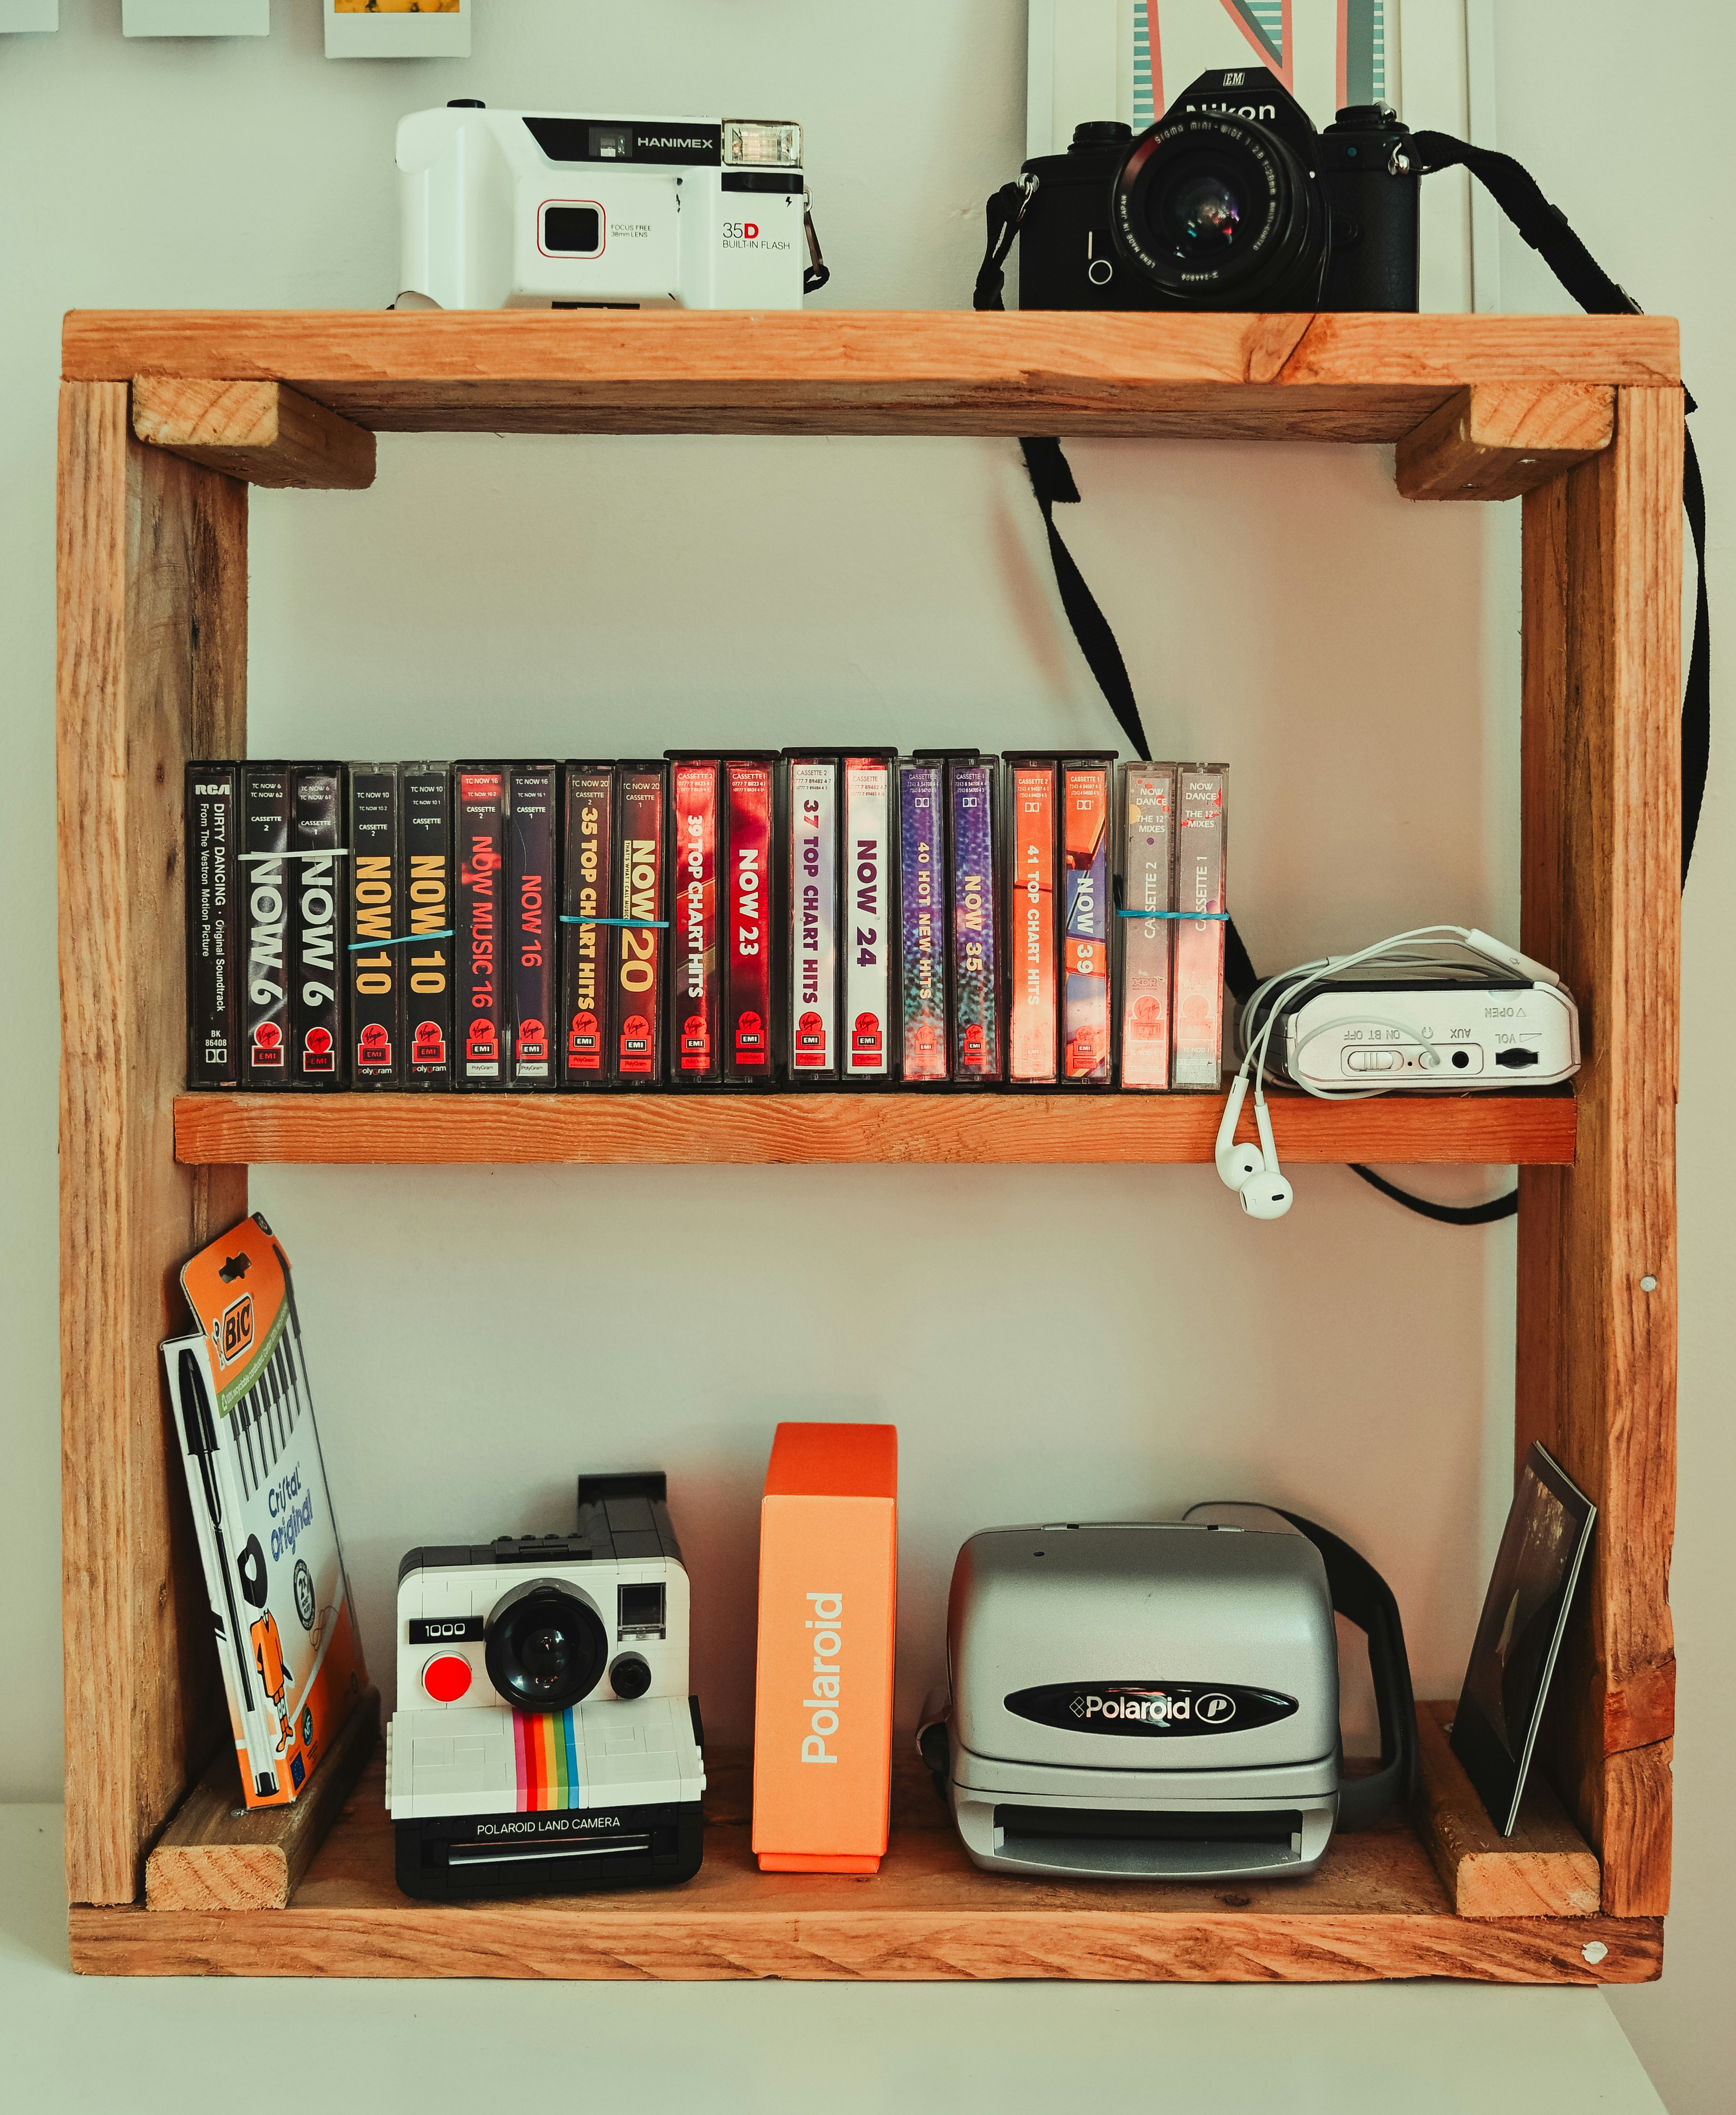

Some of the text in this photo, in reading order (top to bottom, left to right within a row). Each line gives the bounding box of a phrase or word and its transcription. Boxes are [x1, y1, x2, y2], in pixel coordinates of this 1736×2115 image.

[1225, 73, 1243, 85] EM
[637, 138, 713, 149] HANIMEX
[723, 222, 759, 239] 35D
[723, 240, 790, 250] BUILT-IN FLASH
[1123, 223, 1130, 232] IN
[1126, 234, 1141, 253] MADE
[1139, 253, 1156, 269] LENS
[195, 784, 230, 795] RCA
[1185, 792, 1217, 801] DANCE
[200, 803, 209, 826] From
[201, 889, 210, 921] Motion
[214, 803, 226, 1011] DIRTY DANCING Original Soundtrack
[355, 856, 392, 994] NOW 10
[410, 856, 446, 994] NOW 10
[471, 836, 493, 1008] NOW MUSIC 16
[521, 875, 542, 967] NOW 16
[578, 807, 598, 1009] 35 TOP CHART HITS
[621, 840, 656, 992] NOW 20
[688, 815, 703, 998] 39 TOP CHART HITS
[739, 849, 759, 956] NOW 23
[802, 800, 819, 1004] 37 TOP CHART HITS
[857, 840, 877, 967] NOW 24
[918, 842, 932, 1000] 40 HOT NEW HITS
[964, 876, 983, 971] NOW 35
[1027, 845, 1040, 1006] 41 TOP CHART HITS
[1076, 878, 1094, 974] NOW 39
[1144, 873, 1157, 939] CASETTE
[202, 924, 210, 957] Picture
[250, 851, 283, 1005] NOW 6
[302, 855, 335, 1007] NOW 6
[1343, 1029, 1400, 1040] ON BT OFF
[1450, 1028, 1471, 1039] AUX
[1484, 1007, 1514, 1018] OPEN
[1495, 1033, 1516, 1044] VOL
[425, 1623, 465, 1637] 1000
[801, 1592, 843, 1764] Polaroid
[1086, 1696, 1190, 1720] Polaroid
[477, 1817, 620, 1835] POLAROID LAND CAMERA
